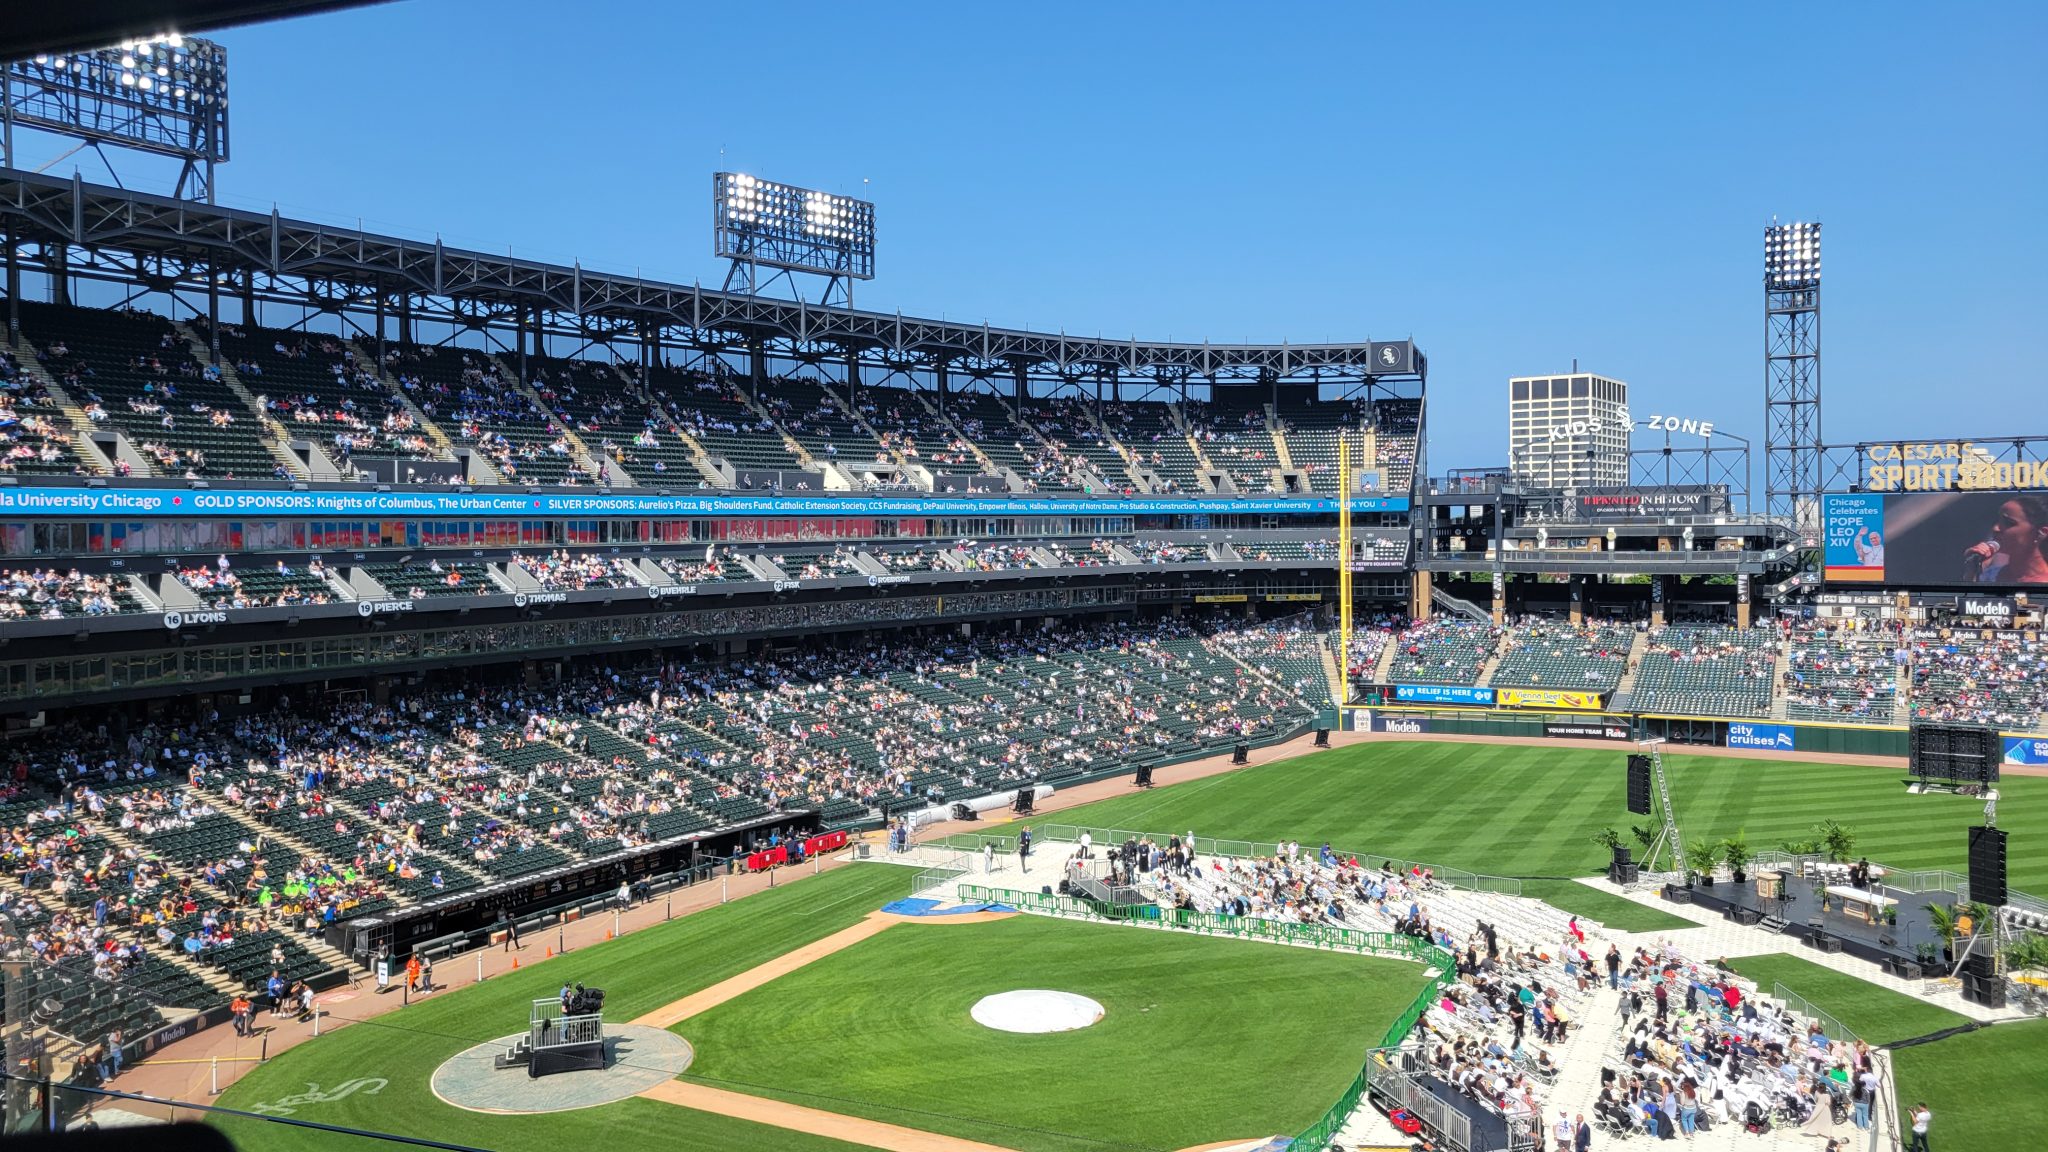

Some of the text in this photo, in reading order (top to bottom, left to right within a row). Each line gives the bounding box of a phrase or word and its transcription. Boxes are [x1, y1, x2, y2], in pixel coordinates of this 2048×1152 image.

[1548, 416, 1713, 442] KIDS ZONE
[1870, 442, 1975, 460] CAESARS
[1869, 462, 2048, 491] SPORTSBOOK
[18, 494, 98, 509] University
[102, 494, 161, 509] Chicago
[194, 496, 526, 510] GOLD SPONSORS: Knights of Columbus, The Urban Center
[549, 499, 582, 509] SILVER
[584, 499, 637, 510] SPONSORS:
[638, 500, 674, 510] Aurelio's
[676, 500, 698, 511] Pizza,
[700, 501, 712, 511] Big
[714, 501, 752, 510] Shoulders
[754, 502, 774, 511] Fund,
[775, 501, 804, 510] Catholic
[806, 502, 840, 510] Extension
[842, 502, 868, 511] Society,
[868, 502, 882, 510] CCS
[884, 502, 922, 512] Fundraising,
[924, 502, 948, 510] DePaul
[949, 502, 978, 512] University,
[979, 502, 1006, 511] Empower
[1008, 502, 1028, 511] Illinois,
[1050, 502, 1078, 512] University
[1079, 502, 1086, 510] of
[1156, 502, 1199, 510] Construction,
[1200, 502, 1230, 511] Pushpay,
[1274, 501, 1311, 510] University
[1641, 496, 1652, 504] IN
[1830, 499, 1866, 507] Chicago
[1830, 517, 1864, 526] POPE
[1830, 528, 1854, 536] LEO
[1830, 538, 1851, 546] XIV
[878, 576, 910, 584] ROBINSON
[660, 586, 696, 595] BUEHRLE
[529, 593, 566, 603] THOMAS
[361, 601, 413, 613] 19 PIERCE
[1966, 601, 2009, 614] Modelo
[168, 612, 226, 624] 16 LYONS
[1915, 630, 1936, 639] Modelo
[1386, 720, 1420, 732] Modelo
[1730, 725, 1753, 736] city
[1606, 728, 1626, 738] Rate
[1730, 736, 1774, 745] cruises
[161, 1026, 186, 1043] Modelo
